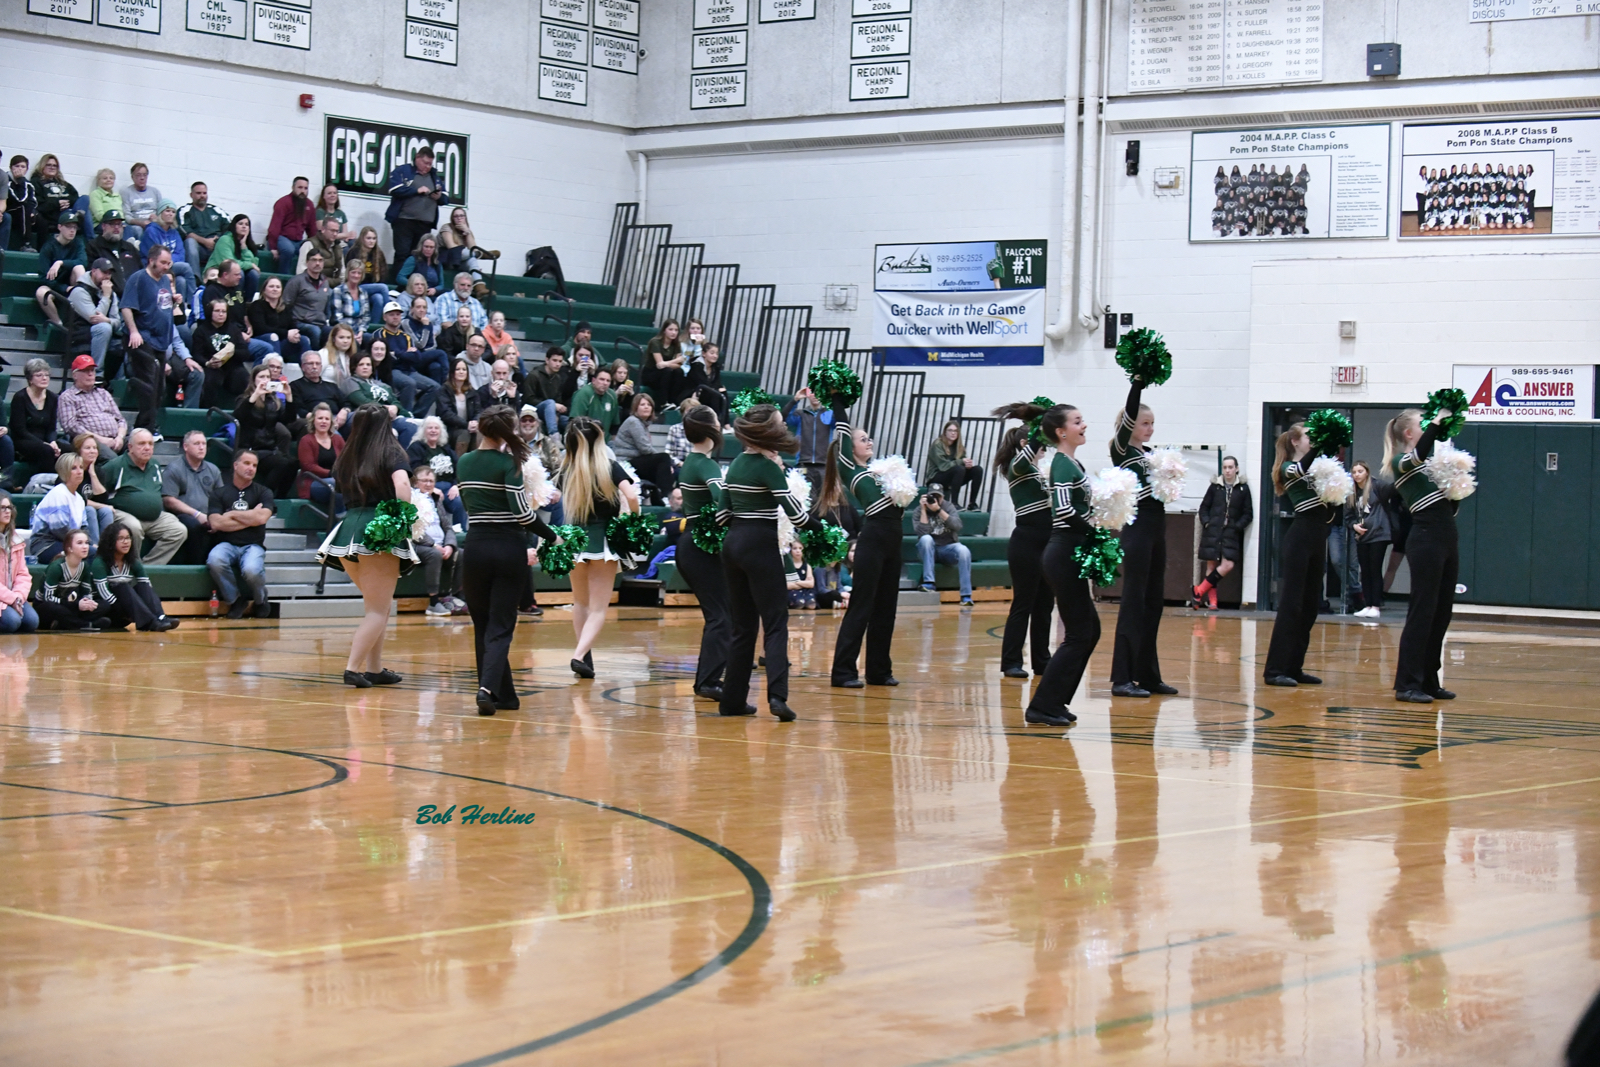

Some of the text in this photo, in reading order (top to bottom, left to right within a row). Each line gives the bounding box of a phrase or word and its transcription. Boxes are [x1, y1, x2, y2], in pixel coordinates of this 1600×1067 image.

[50, 4, 71, 14] 2011
[207, 1, 226, 12] CML
[420, 0, 445, 10] CHAMPS
[599, 0, 634, 13] REGIONAL
[774, 0, 802, 9] CHAMPS
[115, 5, 144, 16] CHAMPS
[424, 9, 441, 18] 2014
[605, 10, 627, 20] CHAMPS
[708, 6, 734, 15] CHAMPS
[1472, 9, 1505, 19] DISCUS
[120, 16, 139, 25] 2018
[201, 12, 232, 23] CHAMPS
[259, 8, 306, 25] DIVISIONAL
[712, 15, 730, 23] 2005
[207, 22, 226, 32] 1987
[269, 22, 296, 33] CHAMPS
[858, 24, 903, 35] REGIONAL
[274, 34, 290, 42] 1998
[410, 25, 453, 41] DIVISIONAL
[547, 28, 582, 42] REGIONAL
[419, 38, 444, 49] CHAMPS
[699, 35, 740, 46] REGIONAL
[866, 35, 895, 43] CHAMPS
[553, 40, 576, 50] CHAMPS
[595, 37, 635, 53] DIVISIONAL
[706, 46, 733, 54] CHAMPS
[423, 49, 440, 57] 2015
[557, 50, 572, 58] 2000
[604, 50, 626, 59] CHAMPS
[711, 55, 728, 63] 2005
[543, 67, 583, 82] DIVISIONAL
[857, 66, 902, 77] REGIONAL
[552, 81, 575, 90] CHAMPS
[695, 76, 741, 87] DIVISIONAL
[865, 78, 894, 86] CHAMPS
[698, 86, 737, 95] CO-CHAMPS
[870, 87, 889, 95] 2007
[1240, 134, 1262, 142] 2004
[1265, 132, 1298, 141] M.A.P.P.
[1519, 136, 1573, 145] Champions
[1298, 142, 1348, 152] Champions
[1005, 248, 1042, 256] FALCONS
[937, 254, 983, 263] 989-695-2525
[1012, 256, 1032, 274] #1
[1015, 275, 1032, 284] FAN
[890, 303, 1026, 316] Get Back in the Game
[887, 320, 1028, 338] Quicker with WellSport
[1338, 367, 1356, 382] EXIT
[1523, 382, 1574, 396] ANSWER
